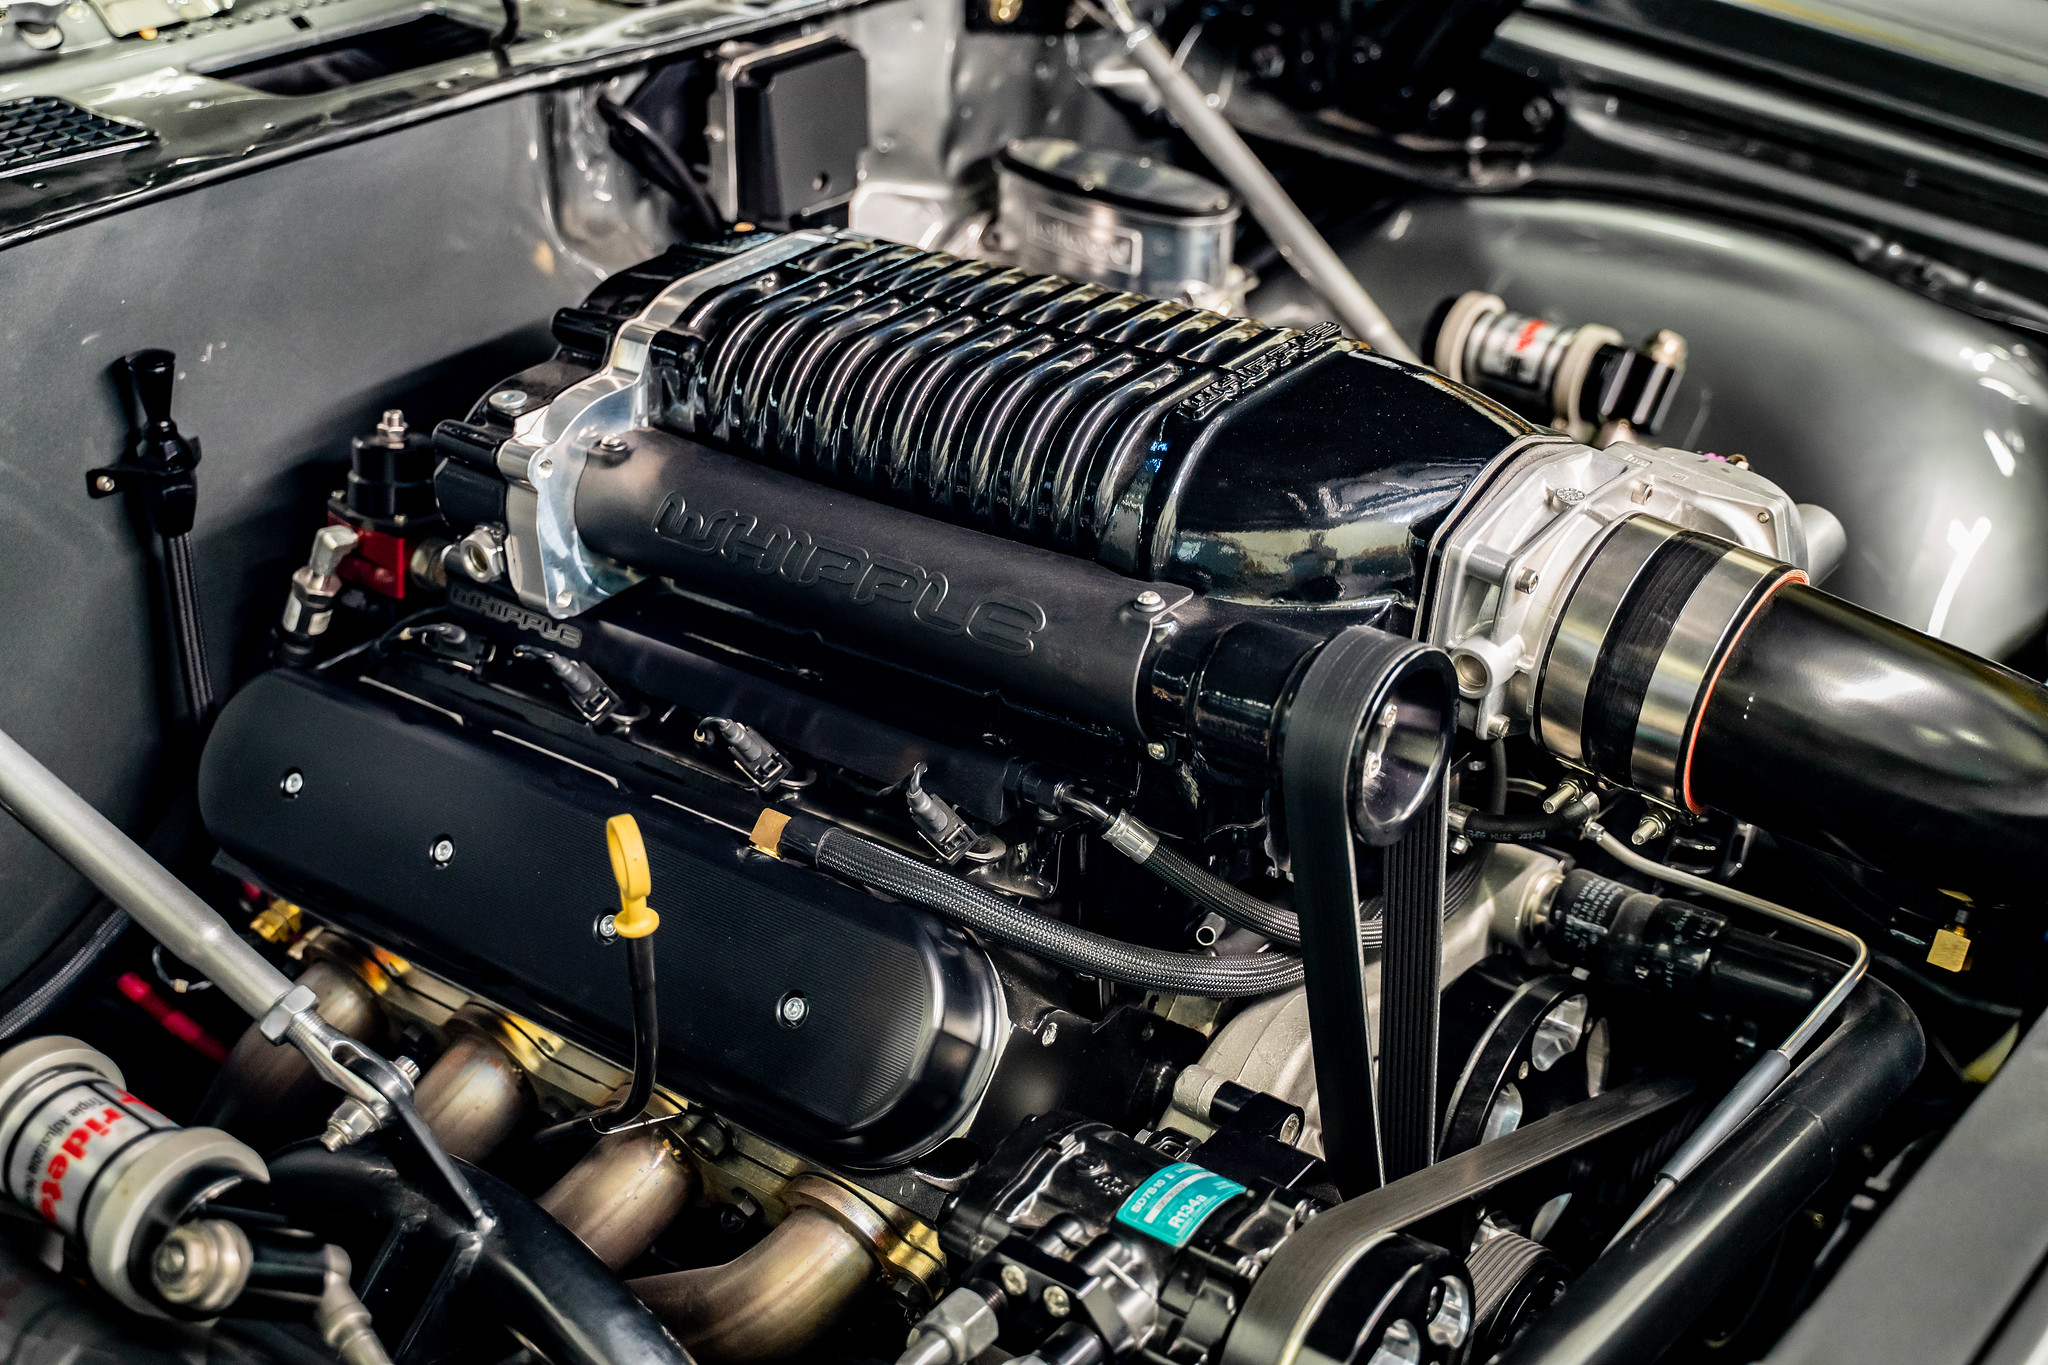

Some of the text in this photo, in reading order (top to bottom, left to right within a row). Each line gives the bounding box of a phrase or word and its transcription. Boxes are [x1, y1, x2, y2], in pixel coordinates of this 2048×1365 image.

[651, 491, 1047, 658] WHIPPLE
[450, 584, 583, 649] WHIPPLE
[1518, 829, 1547, 841] Parker
[1581, 901, 1591, 912] IN
[68, 1096, 108, 1117] Triple
[1168, 1194, 1208, 1229] R134a
